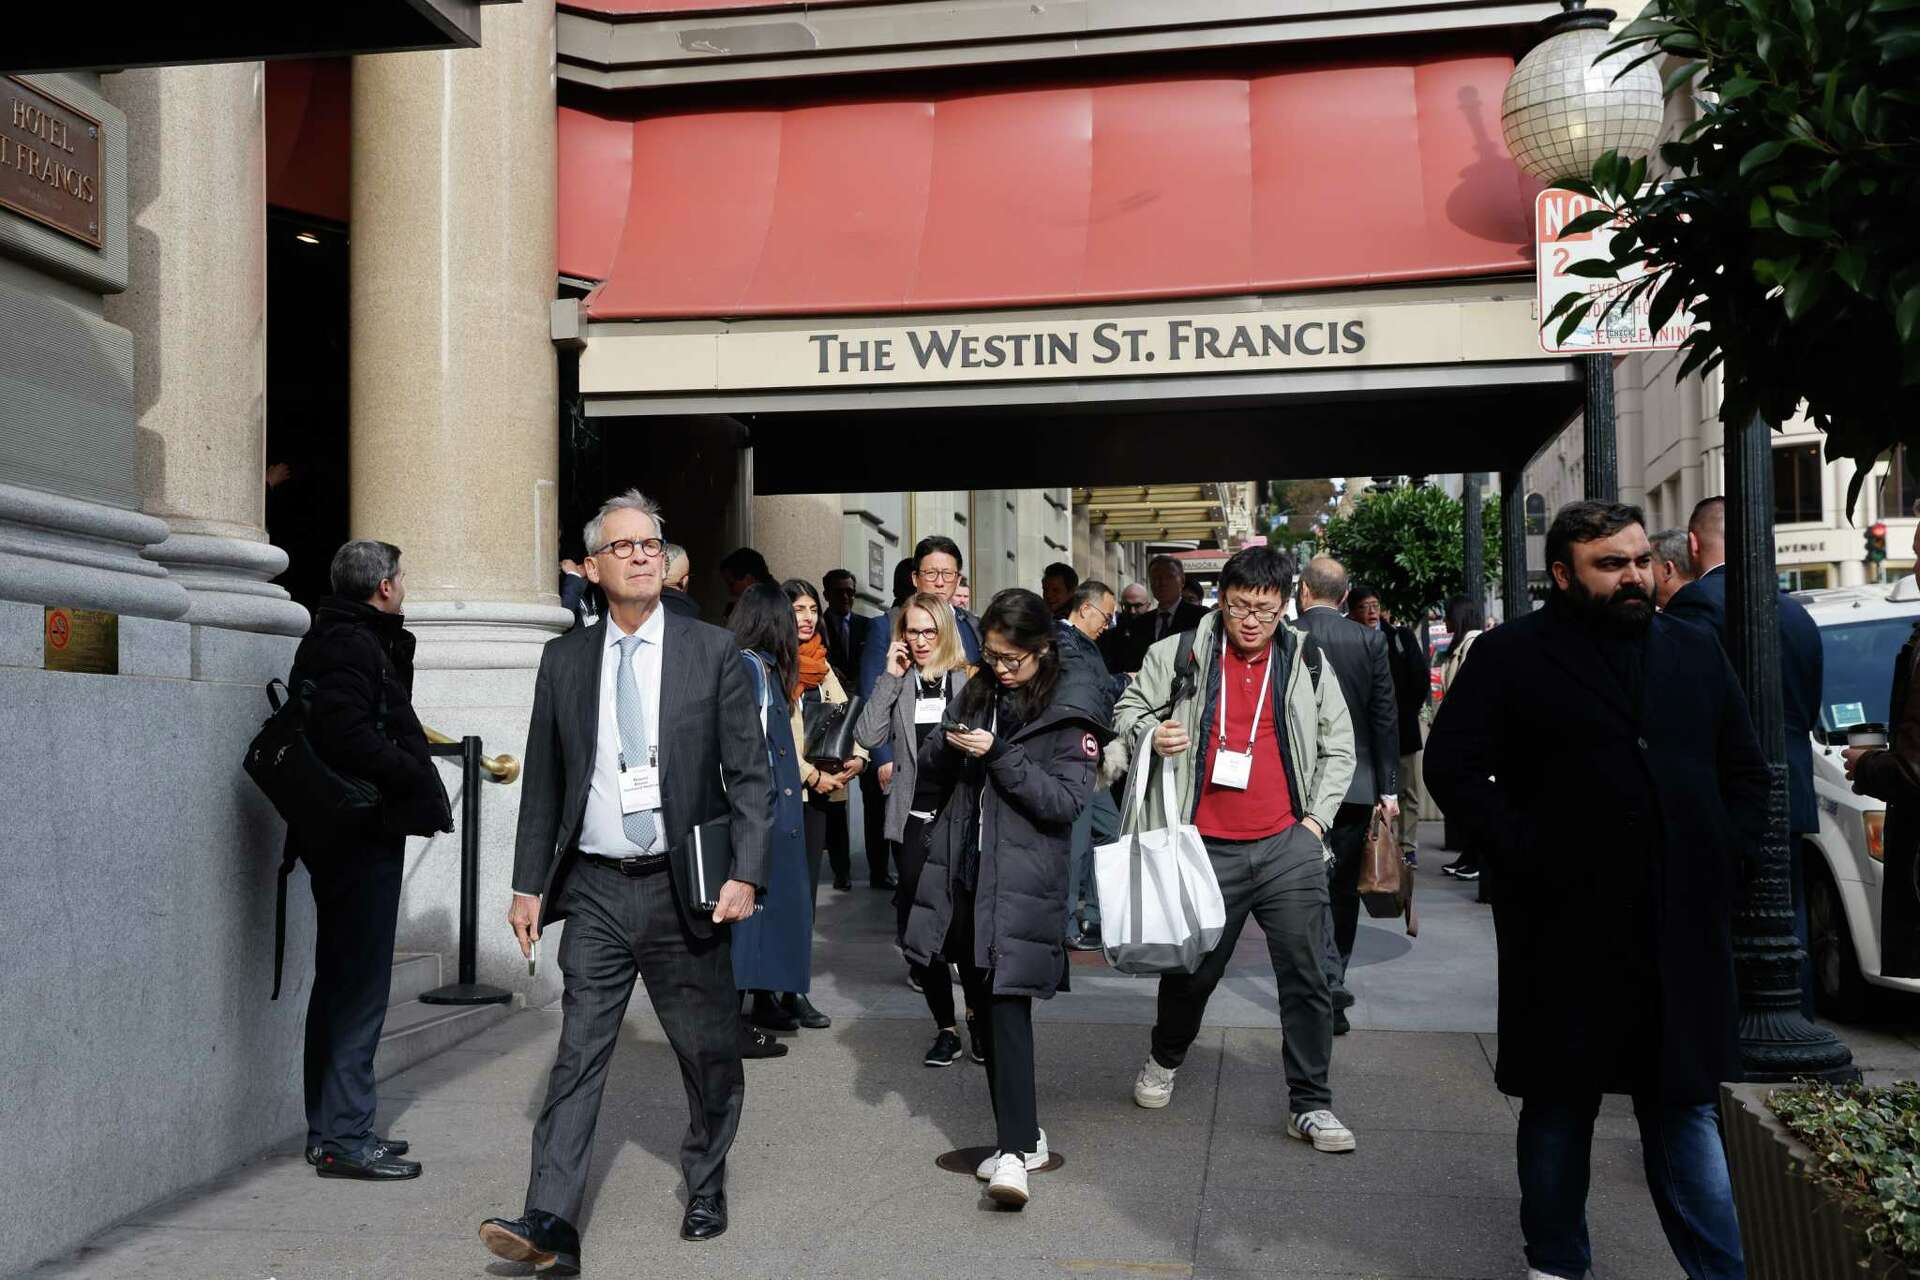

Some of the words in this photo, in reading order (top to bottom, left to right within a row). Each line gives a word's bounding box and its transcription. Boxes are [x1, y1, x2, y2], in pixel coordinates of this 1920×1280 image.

[12, 97, 74, 153] HOTEL
[16, 143, 94, 203] FRANCIS
[808, 334, 896, 373] THE
[906, 329, 1079, 370] WESTIN
[1092, 322, 1156, 364] ST.
[1168, 320, 1366, 360] FRANCIS
[1777, 541, 1825, 554] AVENUE
